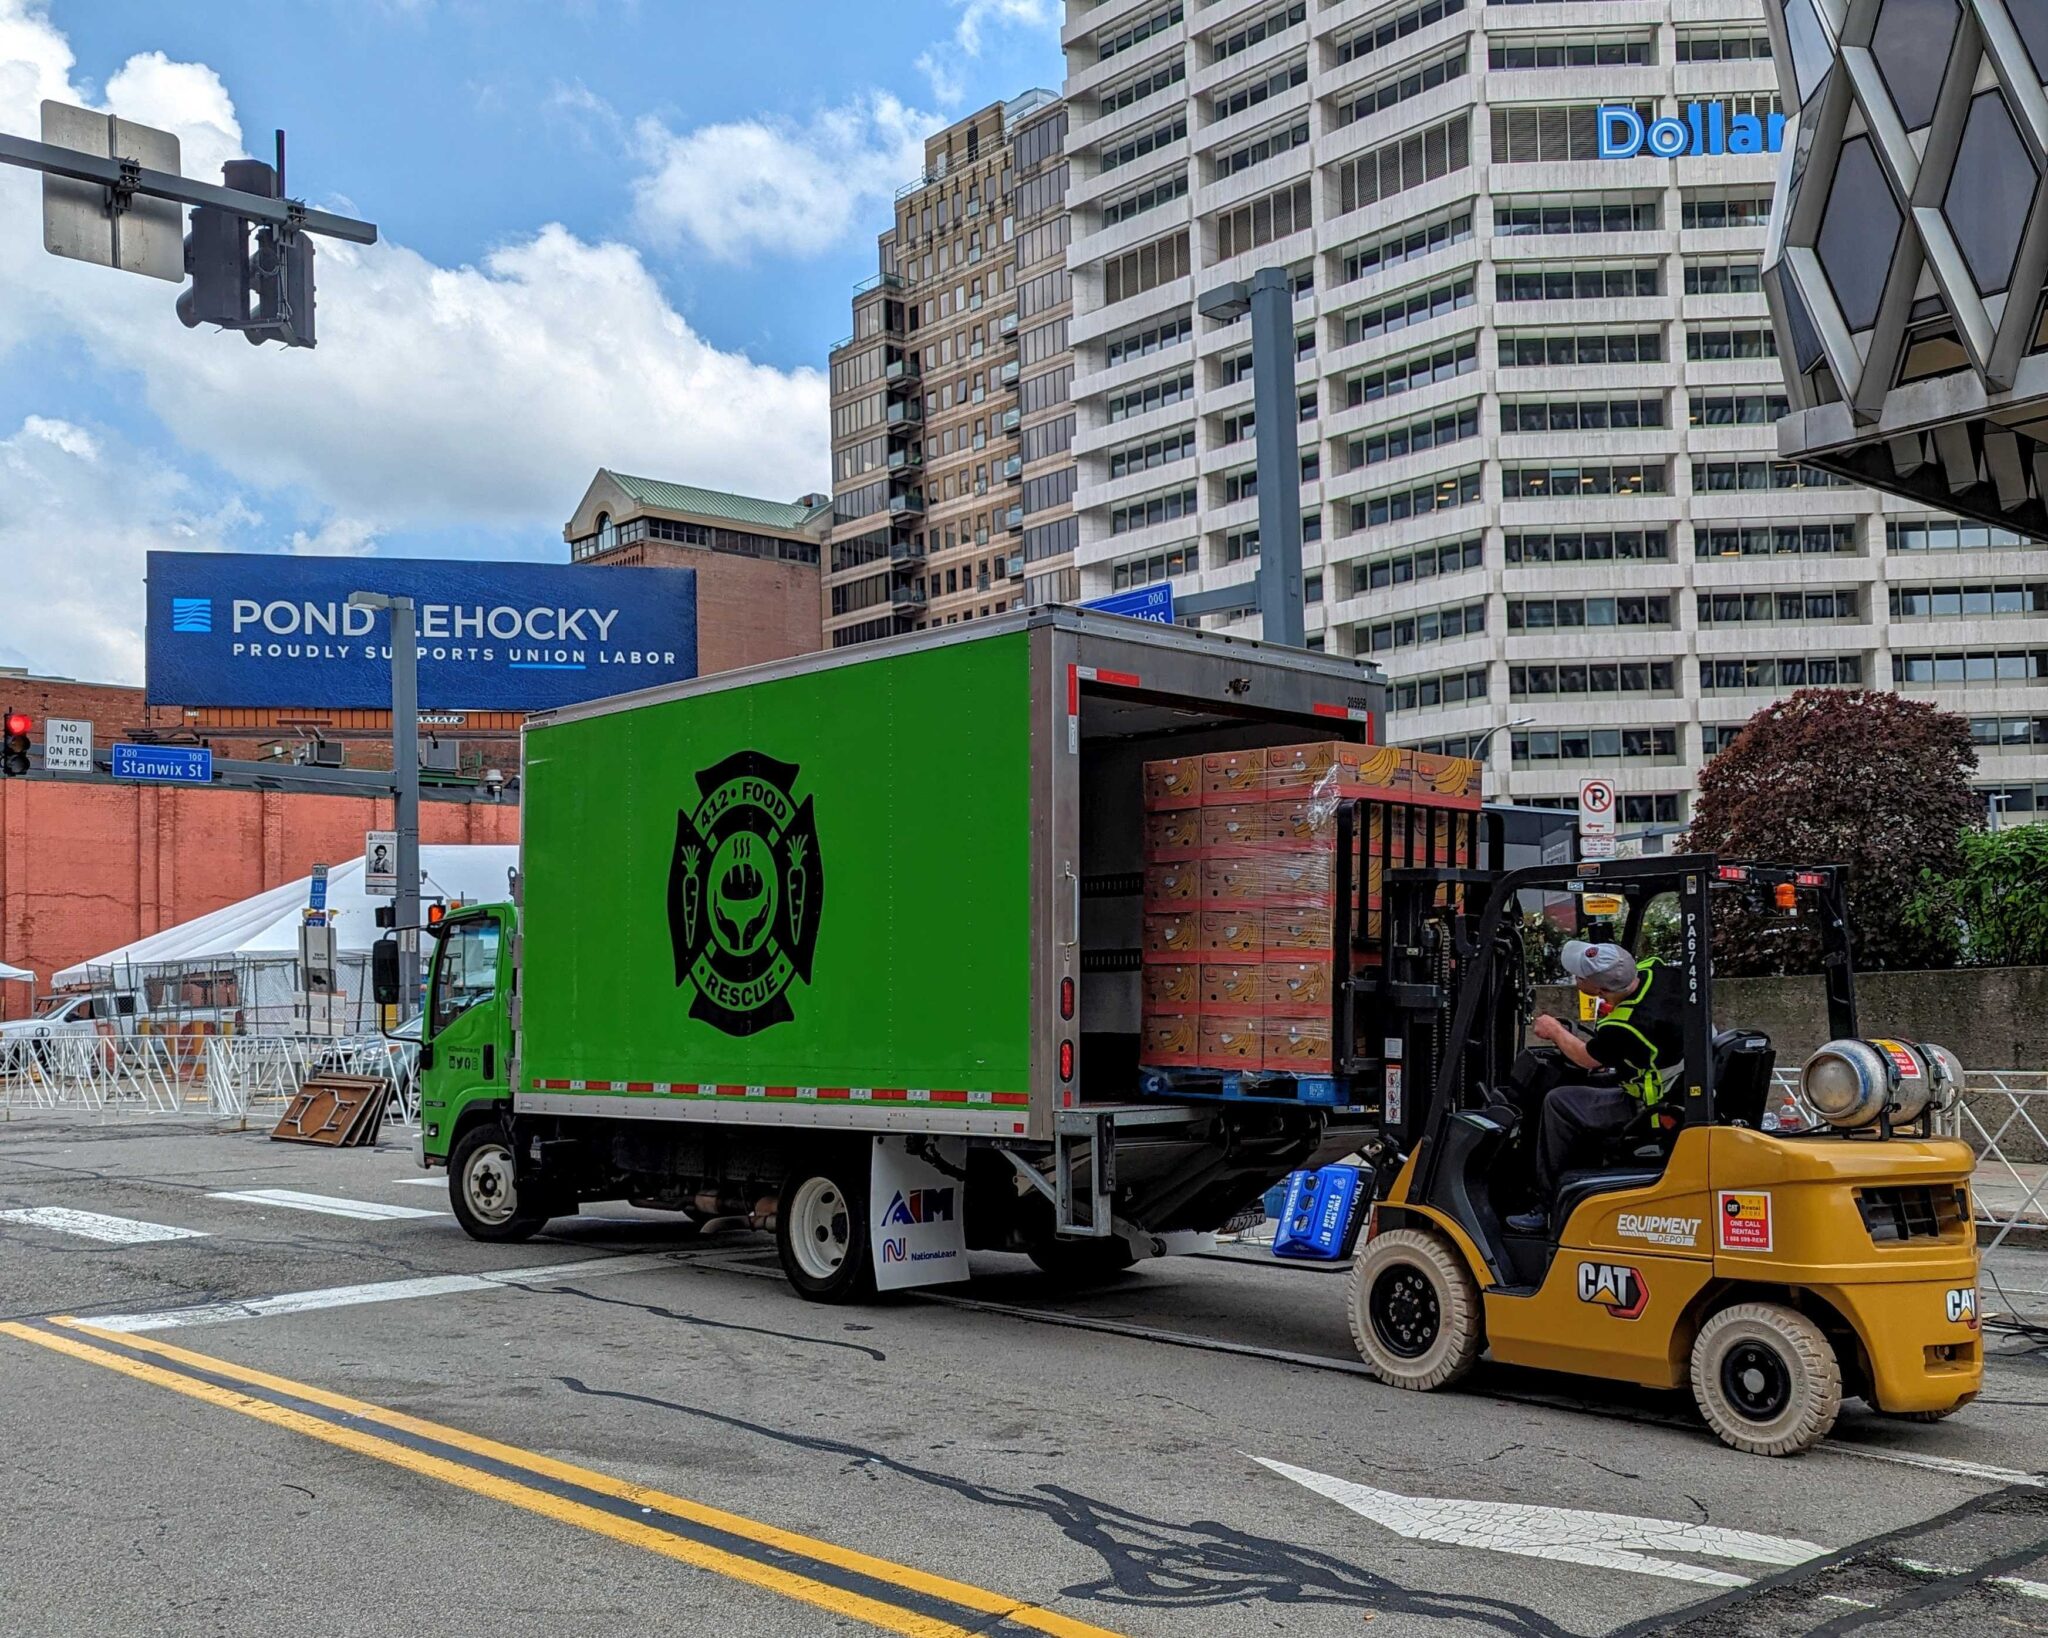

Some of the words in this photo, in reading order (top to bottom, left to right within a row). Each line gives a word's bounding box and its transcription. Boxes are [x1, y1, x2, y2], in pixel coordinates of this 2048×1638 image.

[1597, 102, 1785, 159] Dollar
[1148, 592, 1164, 605] 000
[233, 599, 375, 636] POND
[416, 604, 619, 642] EHOCKY
[233, 643, 349, 659] PROUDLY
[364, 646, 495, 661] SUPORTS
[509, 649, 585, 663] UNION
[599, 651, 676, 665] LABOR
[60, 723, 78, 733] NO
[416, 715, 460, 724] AMAR
[55, 735, 83, 745] TURN
[49, 746, 63, 756] ON
[68, 747, 89, 757] RED
[121, 749, 138, 757] 200
[188, 753, 203, 761] 100
[122, 760, 183, 777] Stanwix
[188, 764, 203, 777] St
[701, 789, 729, 829] 412
[742, 781, 787, 820] FOOD
[314, 883, 324, 892] TO
[311, 897, 325, 907] EAST
[1686, 913, 1698, 1005] PA67464
[705, 970, 779, 1007] RESCUE
[881, 1187, 955, 1227] AIM
[1323, 1199, 1335, 1228] BOTTLES
[1328, 1213, 1338, 1229] CANS
[1333, 1195, 1342, 1212] ONLY
[1727, 1203, 1739, 1212] CAT
[1617, 1214, 1702, 1236] EQUIPMENT
[1731, 1228, 1760, 1236] RENTALS
[1657, 1234, 1691, 1245] DEPOT
[1578, 1262, 1632, 1307] CAT
[1946, 1288, 1976, 1322] CAT
